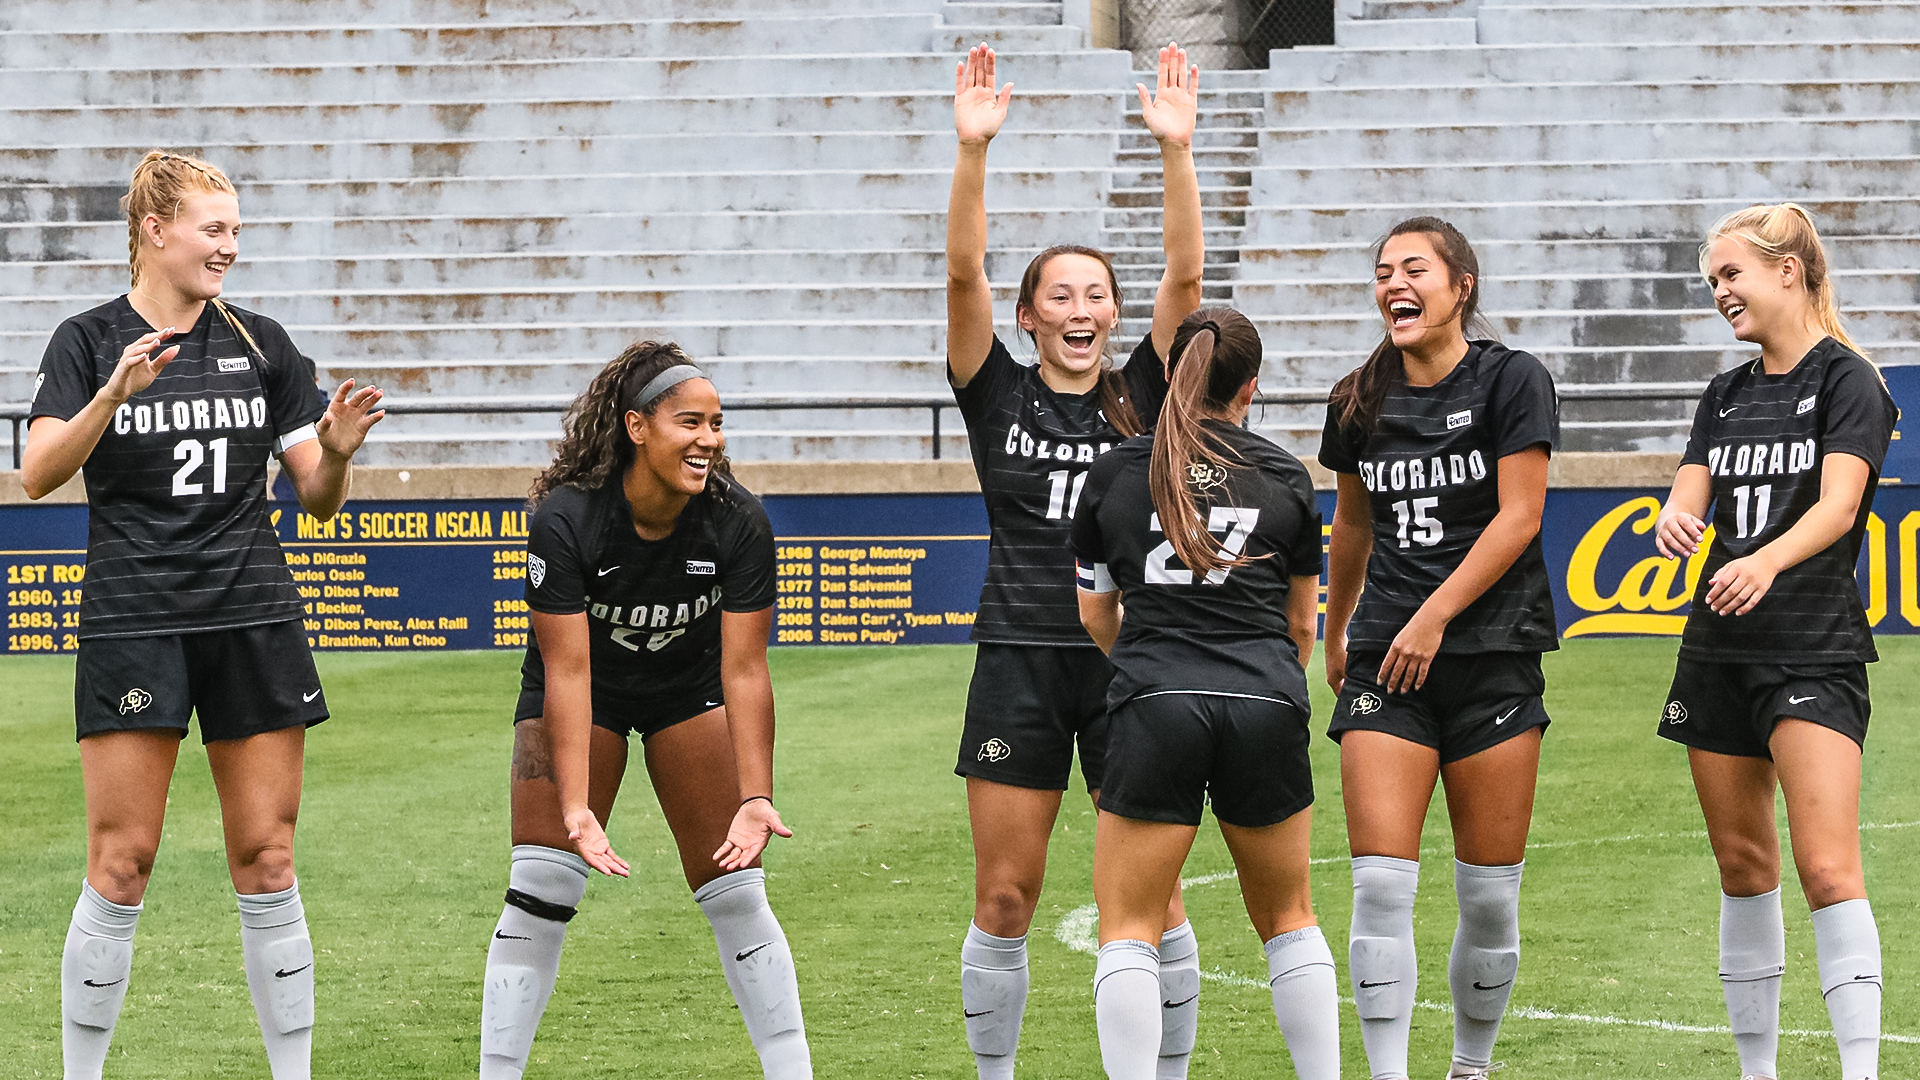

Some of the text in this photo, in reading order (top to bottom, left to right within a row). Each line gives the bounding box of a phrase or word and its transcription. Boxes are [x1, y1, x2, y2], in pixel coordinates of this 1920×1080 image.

[114, 397, 266, 435] COLORADO
[172, 437, 228, 497] 21
[1358, 449, 1487, 492] OLORADO
[1733, 484, 1772, 539] 11
[297, 512, 352, 539] MEN'S
[360, 512, 428, 538] SOCCER
[436, 511, 492, 538] NSCAA
[500, 511, 529, 537] ALL
[1392, 496, 1444, 549] 15
[1144, 506, 1260, 586] 27
[286, 553, 310, 566] Bob
[493, 551, 527, 563] 1963
[820, 547, 866, 561] George
[870, 547, 926, 561] Montoya
[8, 565, 86, 584] 1ST RO
[329, 569, 365, 581] Ossio
[493, 567, 526, 579] 1964
[820, 563, 846, 575] Dan
[849, 563, 911, 575] Salvemini
[324, 586, 360, 597] Dibos
[364, 585, 399, 597] Perez
[777, 580, 912, 592] 1977 Dan Salvemini
[8, 590, 57, 606] 1960,
[777, 596, 912, 609] 1978 Dan Salvemini
[316, 602, 364, 614] Becker,
[494, 600, 530, 612] 1965
[584, 585, 722, 628] OLORADO
[9, 612, 58, 628] 1983,
[324, 618, 360, 630] Dibos
[364, 618, 403, 631] Perez,
[406, 618, 435, 629] Alex
[778, 613, 813, 625] 2005
[820, 613, 858, 625] Calen
[904, 613, 942, 627] Tyson
[9, 634, 58, 651] 1996,
[319, 635, 381, 647] Braathen,
[385, 635, 409, 646] Kun
[413, 634, 446, 646] Choo
[494, 633, 528, 645] 1967
[778, 630, 813, 642] 2006
[820, 630, 857, 642] Steve
